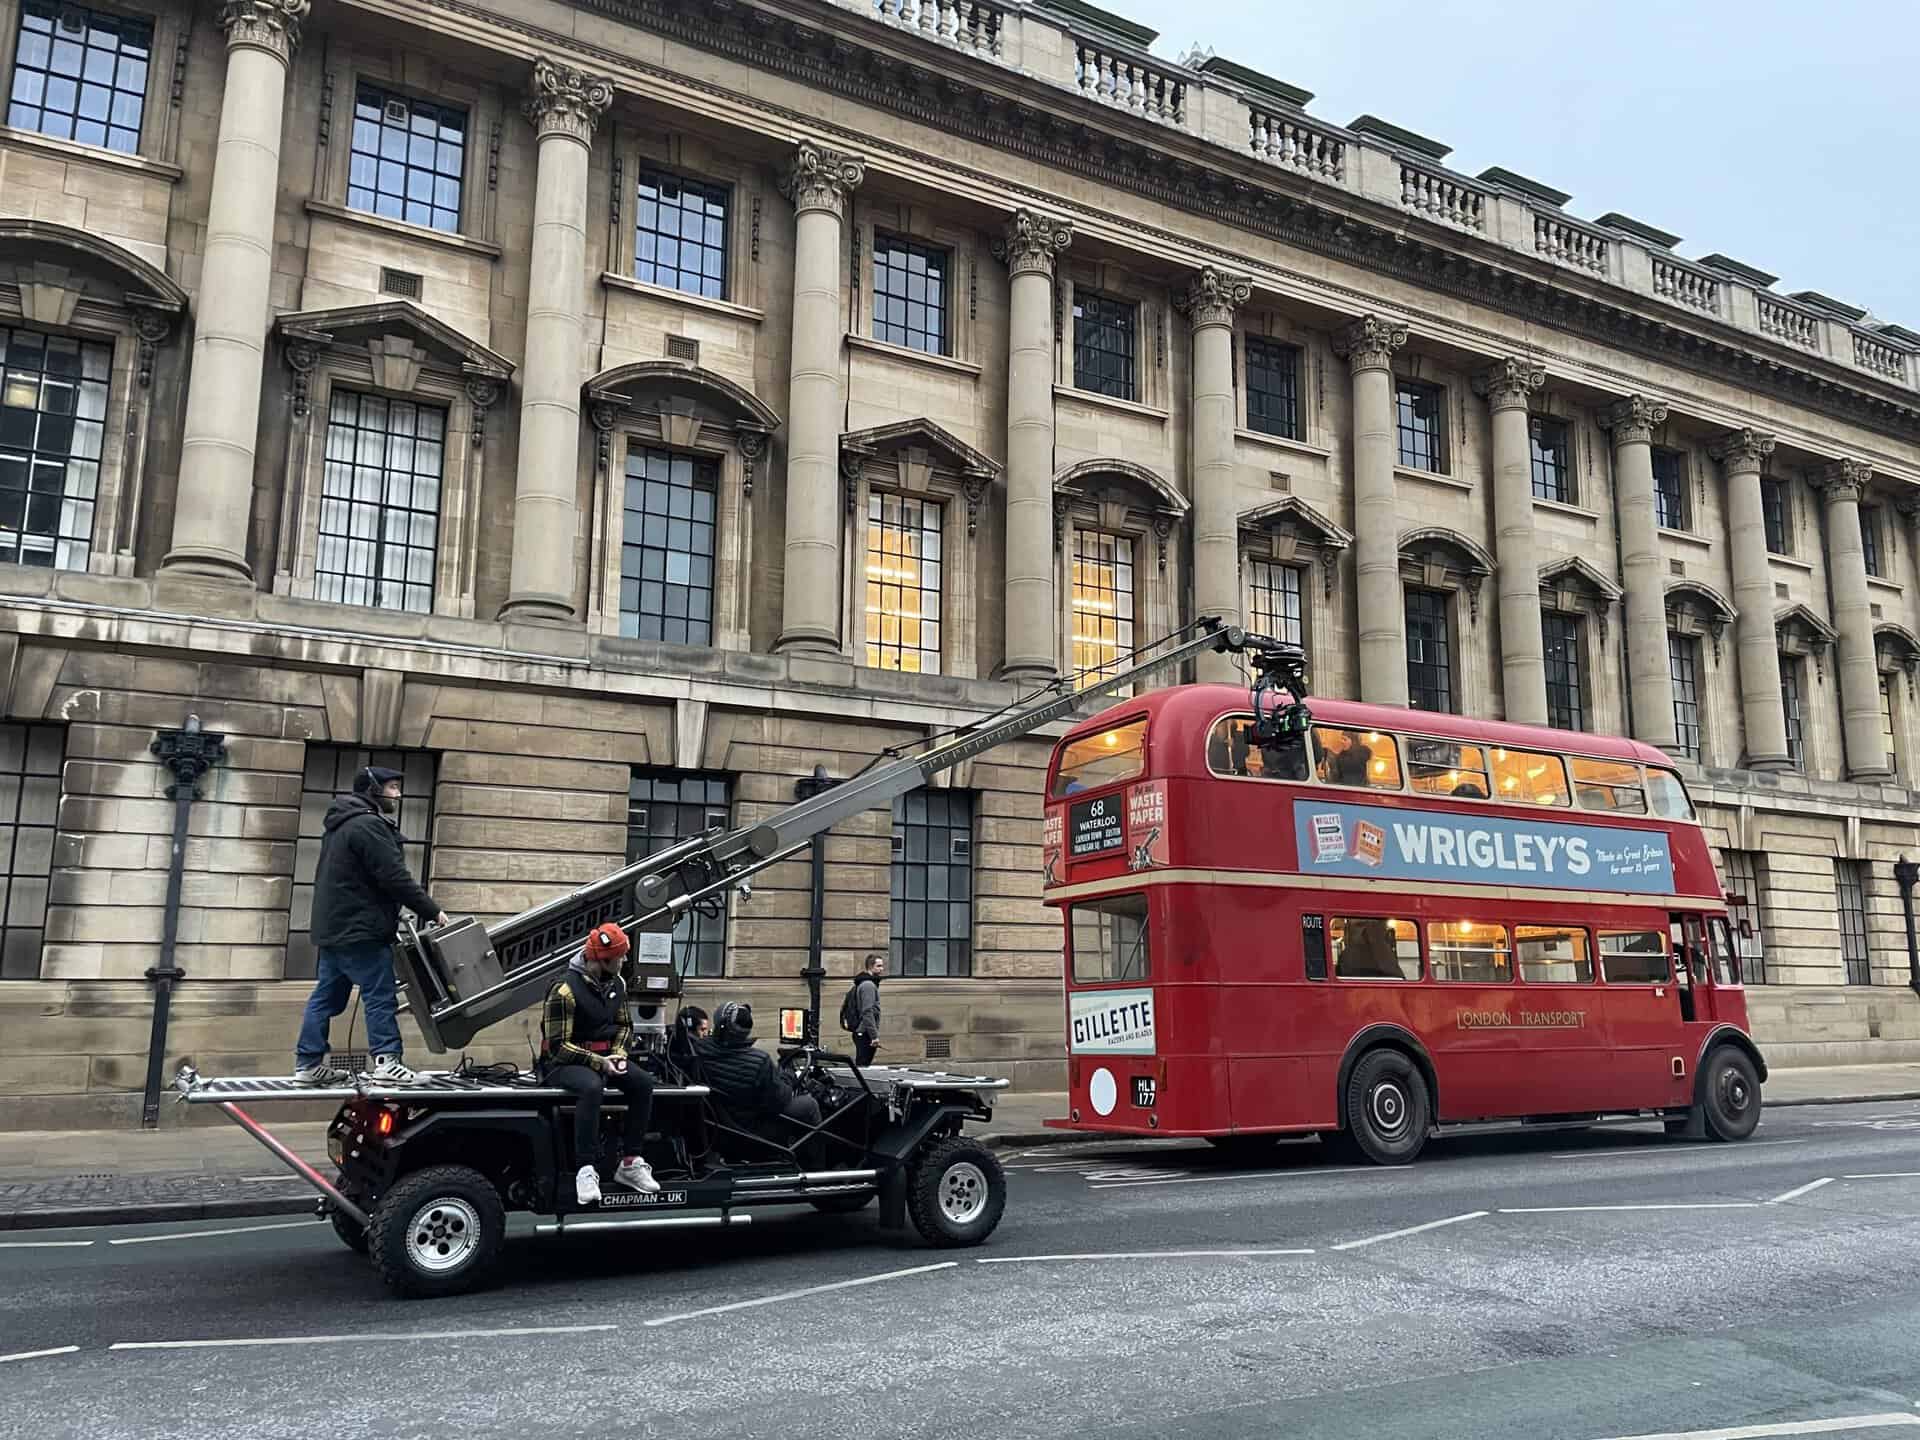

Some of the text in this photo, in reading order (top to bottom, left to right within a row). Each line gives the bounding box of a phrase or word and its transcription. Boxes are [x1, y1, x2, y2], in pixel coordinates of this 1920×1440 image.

[1090, 800, 1104, 817] 68
[1130, 792, 1163, 810] WASTE
[1044, 815, 1063, 831] ASTE
[1080, 815, 1117, 832] WATERLOO
[1130, 808, 1163, 825] PAPER
[1044, 830, 1063, 845] APER
[1393, 823, 1591, 875] WRIGLEY'S
[1302, 916, 1323, 929] ROUTE
[1073, 1001, 1151, 1044] GILLETTE
[1456, 1010, 1586, 1029] LONDON TRANSPORT
[1139, 1092, 1155, 1105] 177
[603, 1193, 658, 1205] CHAPMAN
[667, 1192, 683, 1203] UK
